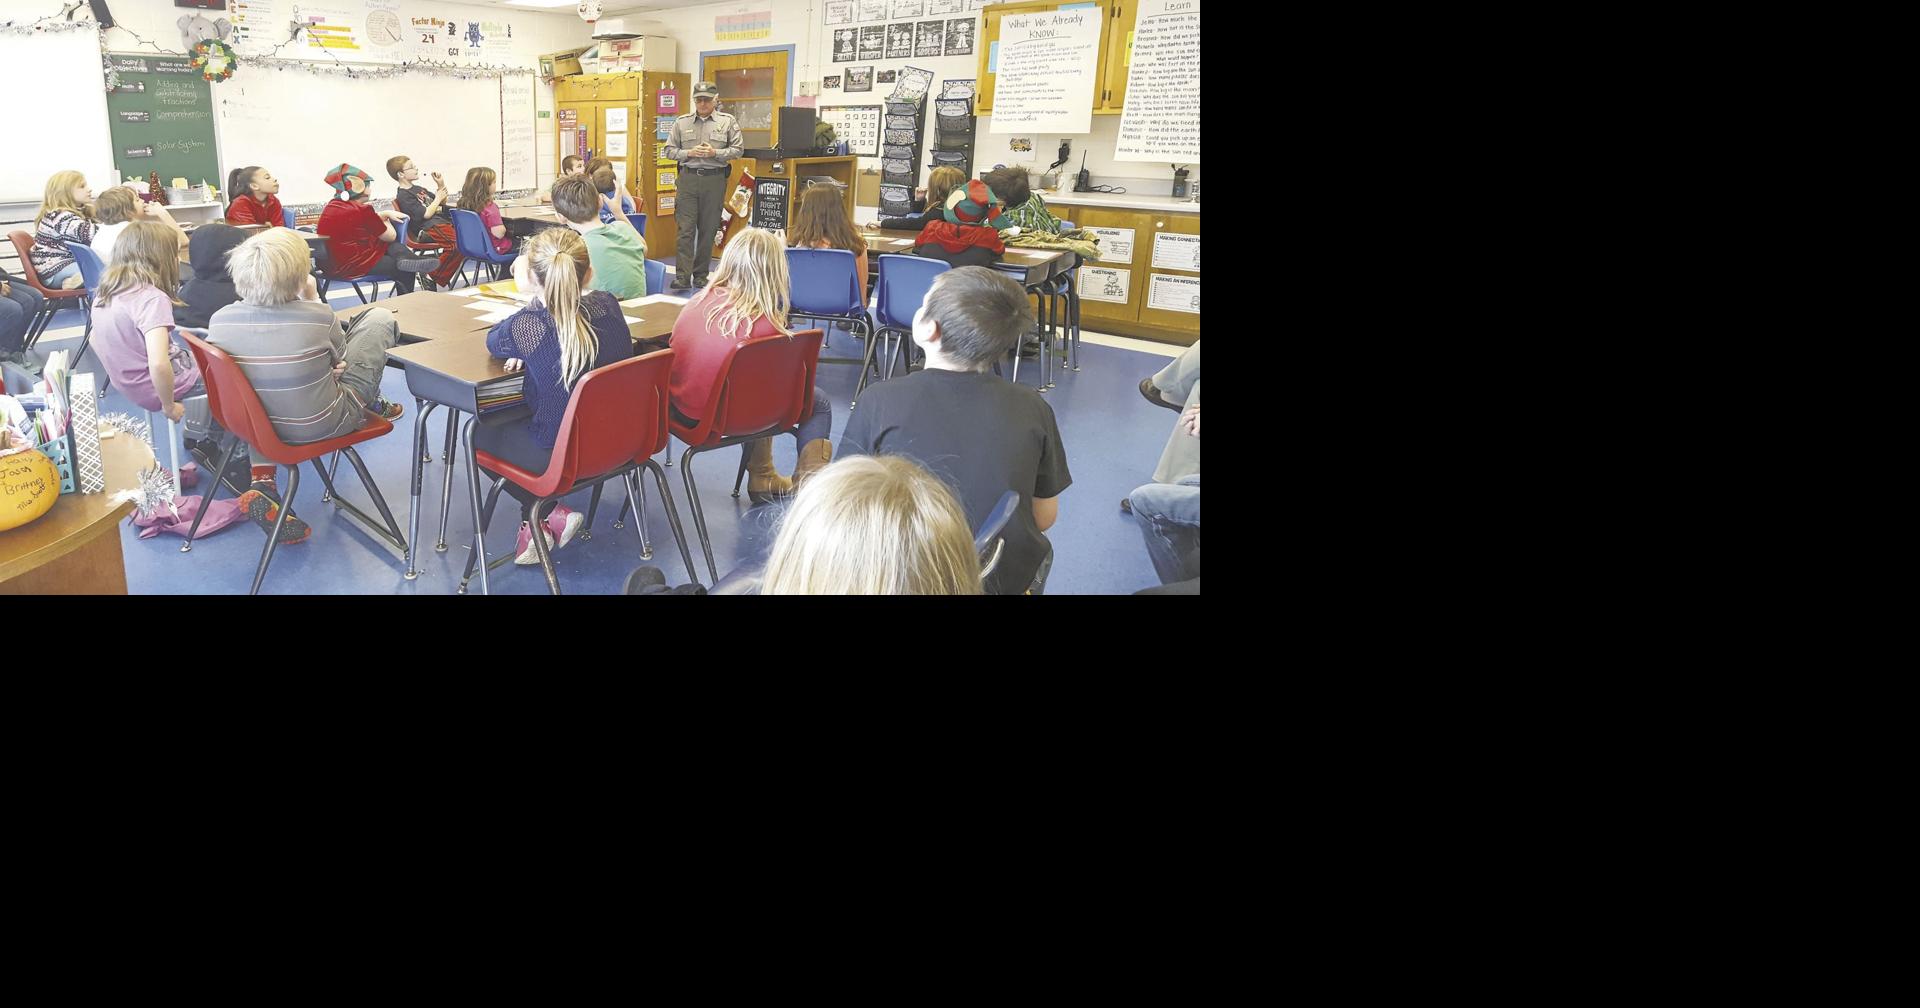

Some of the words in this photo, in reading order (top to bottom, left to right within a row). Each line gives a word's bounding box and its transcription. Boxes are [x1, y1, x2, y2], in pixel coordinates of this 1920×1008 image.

[1164, 2, 1191, 12] Learn
[411, 18, 430, 26] Factor
[1008, 18, 1030, 28] What
[1035, 18, 1048, 27] We
[1052, 14, 1084, 27] Already
[422, 34, 434, 44] 24
[156, 80, 180, 91] Adding
[182, 81, 194, 89] and
[156, 142, 176, 152] Solar
[178, 140, 205, 152] System
[758, 182, 786, 196] INTEGRITY
[760, 201, 781, 209] RIGHT
